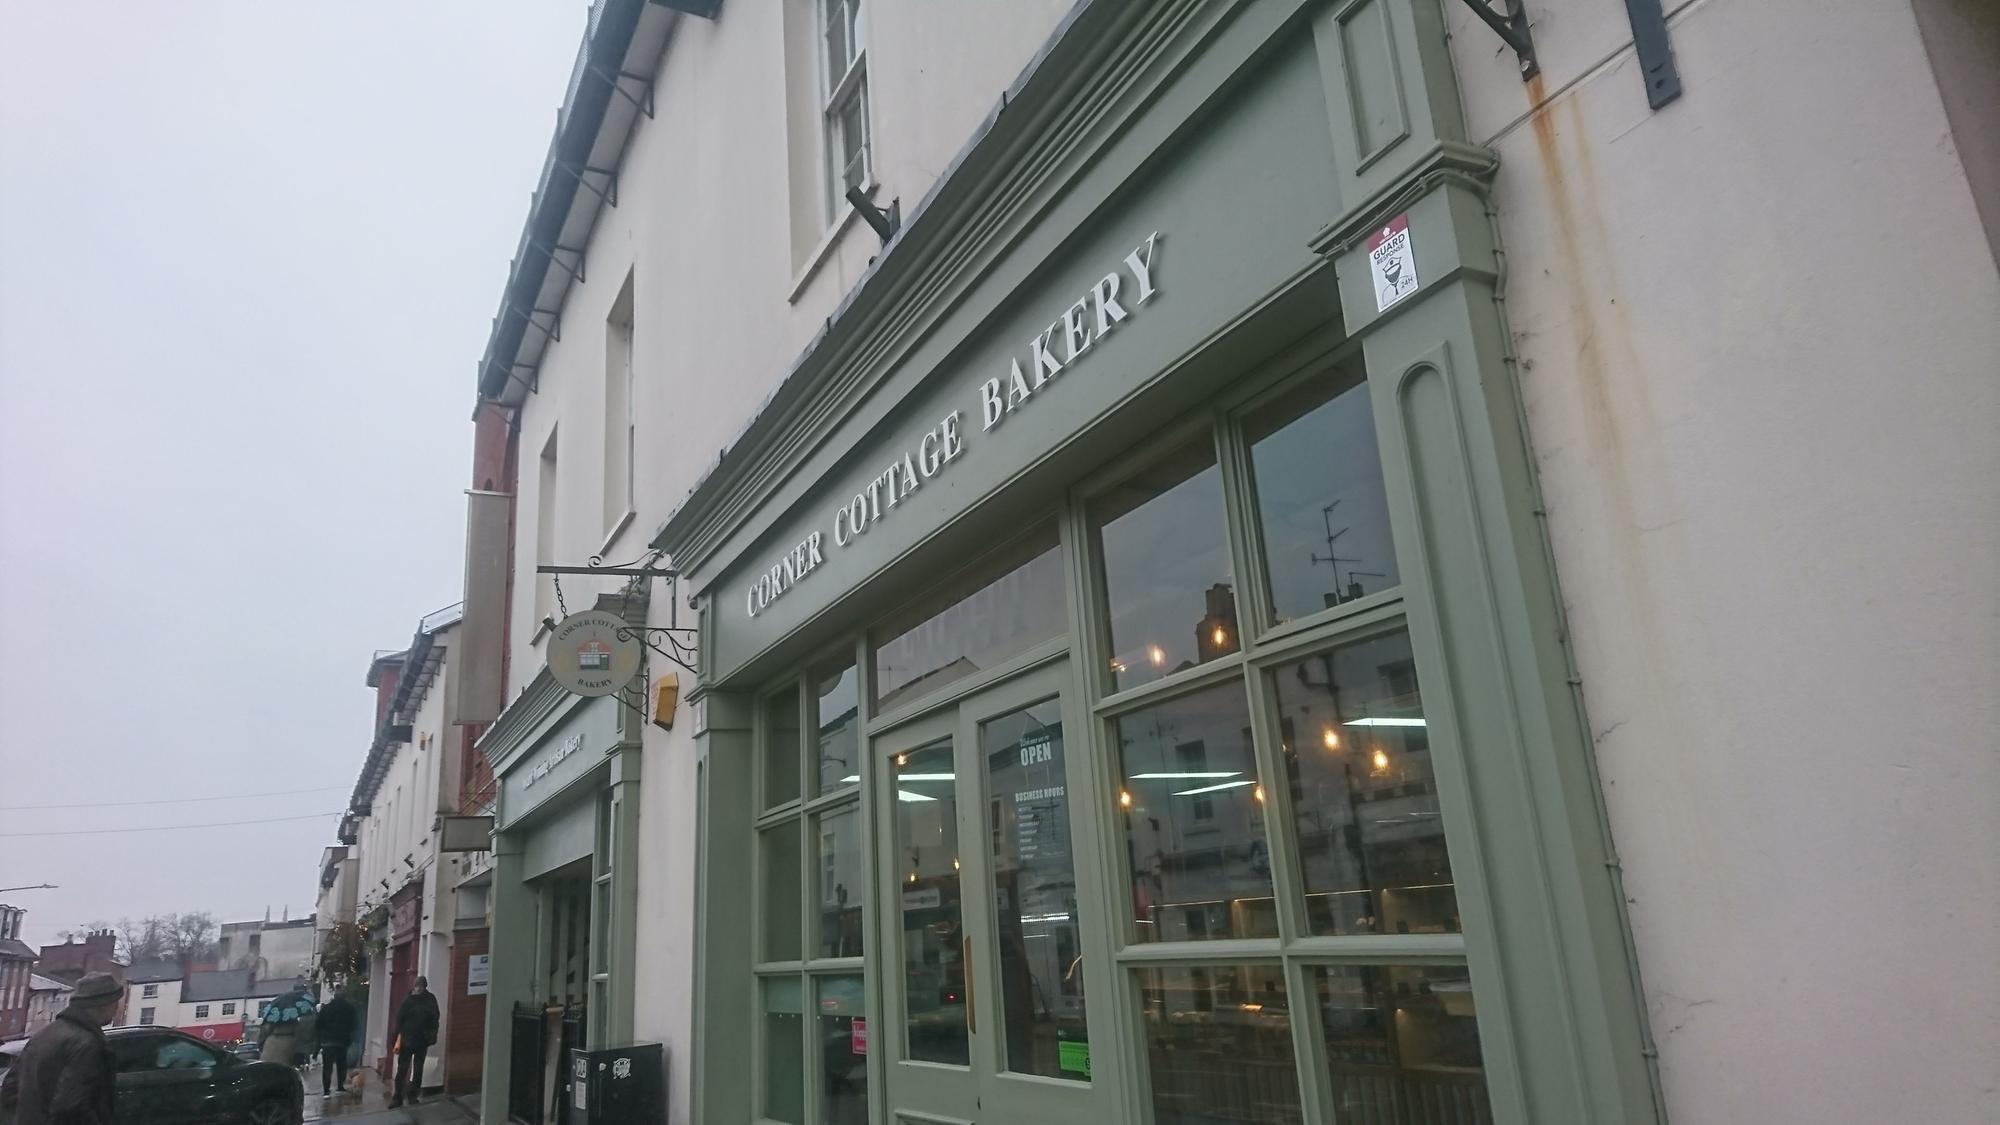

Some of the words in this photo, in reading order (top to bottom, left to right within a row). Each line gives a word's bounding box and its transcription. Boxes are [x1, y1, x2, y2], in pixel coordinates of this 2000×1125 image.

[1373, 233, 1405, 260] GUARD
[746, 531, 823, 617] CORNER
[834, 410, 963, 547] COTTAGE
[979, 231, 1159, 432] BAKERY
[559, 619, 591, 640] CORNER
[577, 678, 612, 688] BAKERY
[1020, 741, 1052, 766] OPEN
[1015, 789, 1043, 802] BUSINESS
[1044, 786, 1065, 798] HOURS
